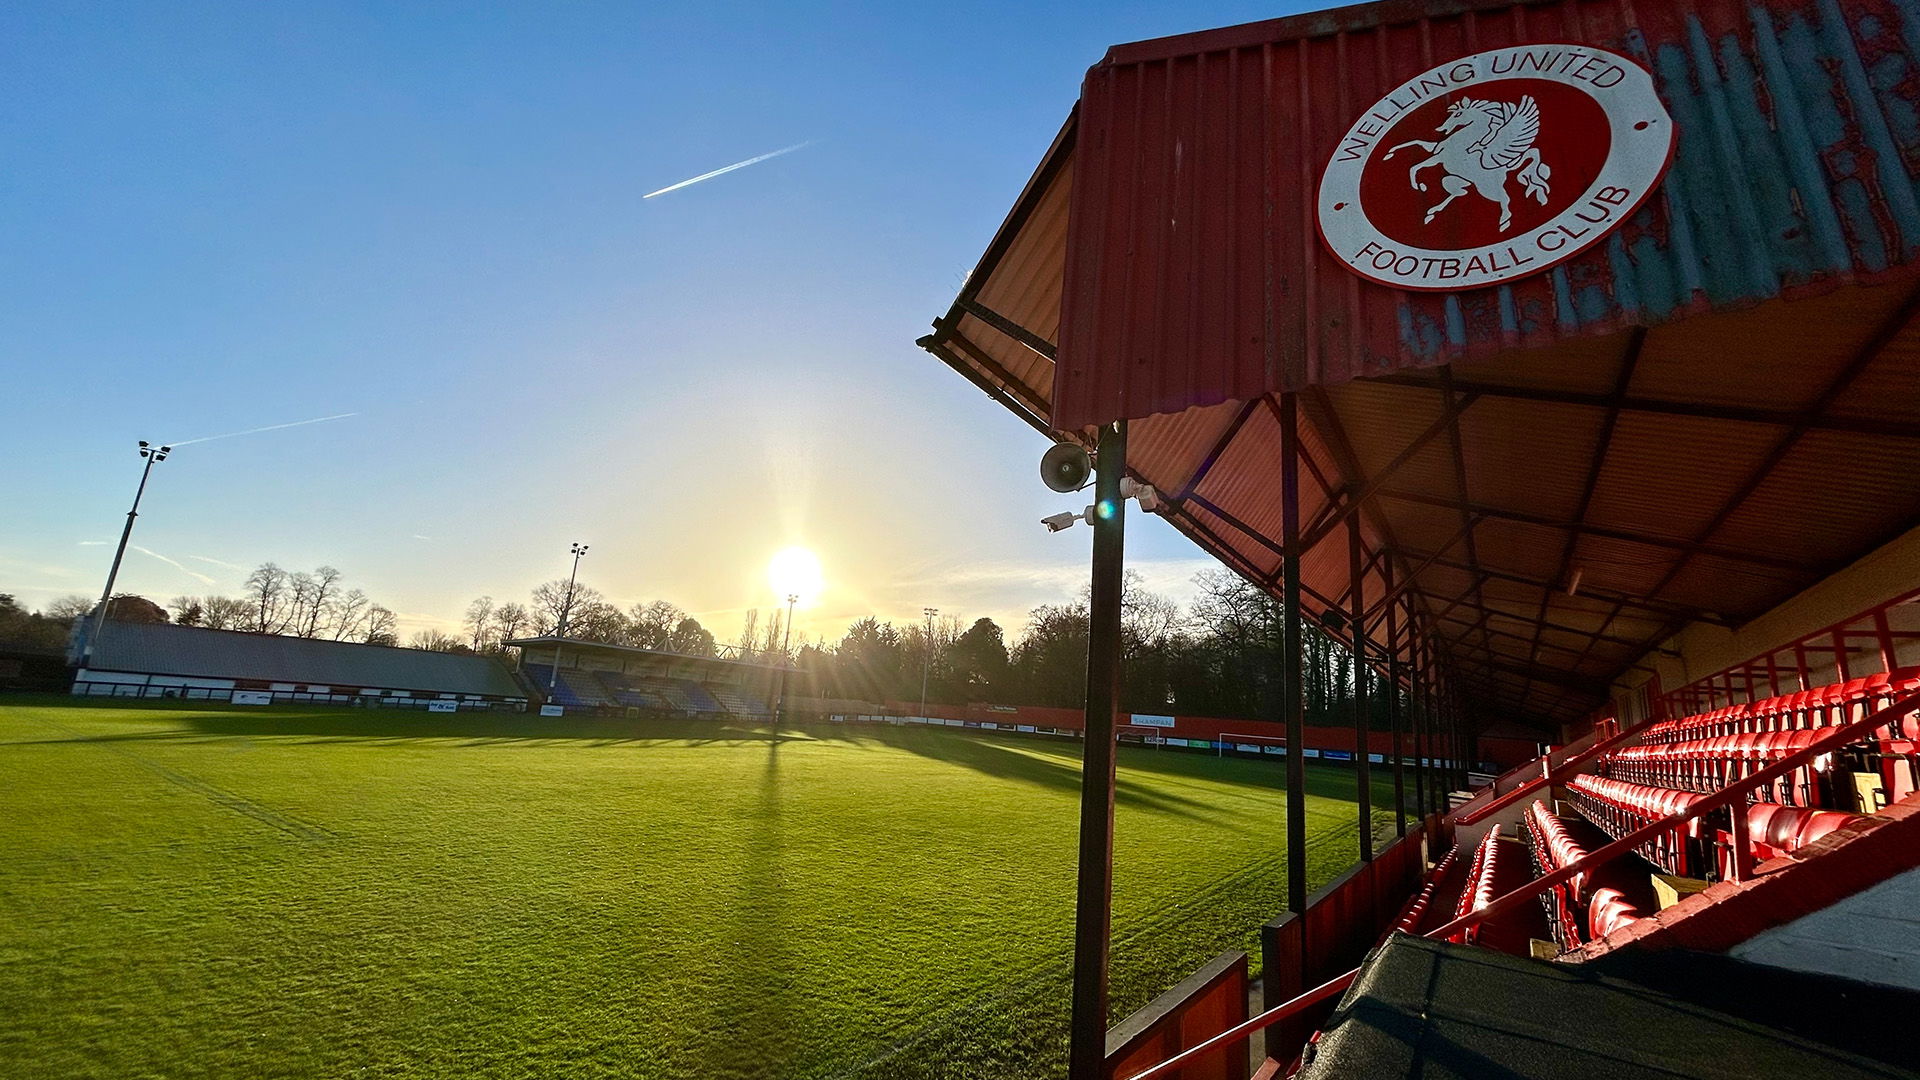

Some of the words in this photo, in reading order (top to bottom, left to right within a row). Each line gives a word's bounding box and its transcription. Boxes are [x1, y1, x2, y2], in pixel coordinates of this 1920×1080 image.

[1337, 63, 1475, 162] WELLING
[1491, 51, 1626, 88] UNITED
[1355, 241, 1533, 279] FOOTBALL
[1536, 185, 1630, 251] CLUB
